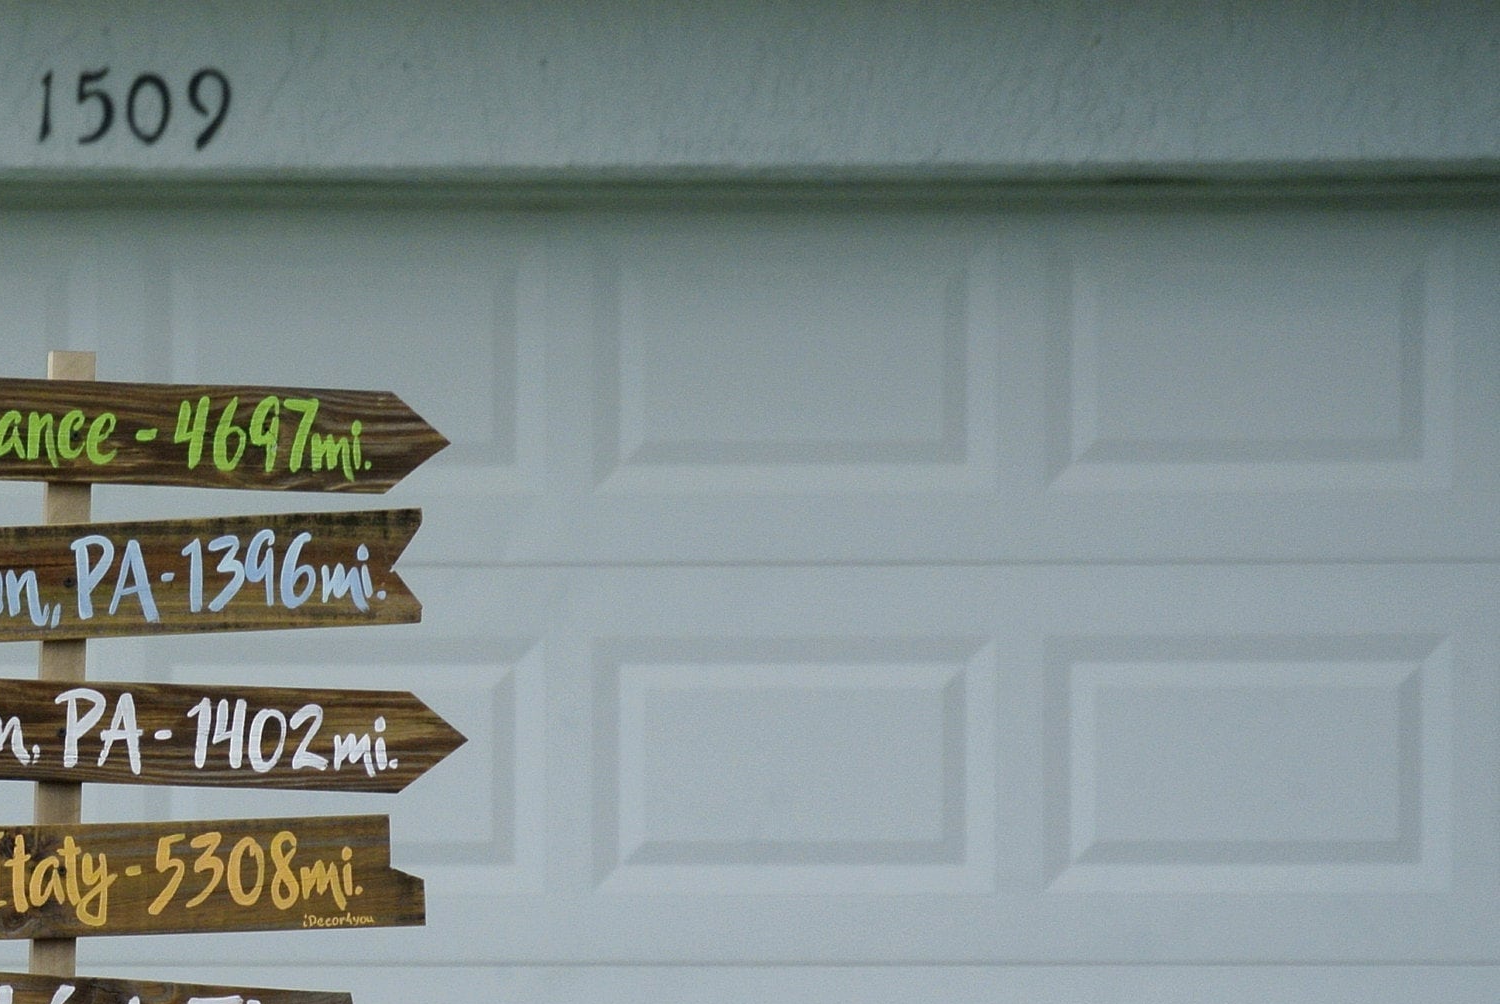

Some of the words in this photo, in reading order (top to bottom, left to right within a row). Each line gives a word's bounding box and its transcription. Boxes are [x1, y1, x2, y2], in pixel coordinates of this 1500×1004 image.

[39, 66, 231, 151] 1509
[70, 534, 159, 624] PA
[55, 687, 144, 774] PA
